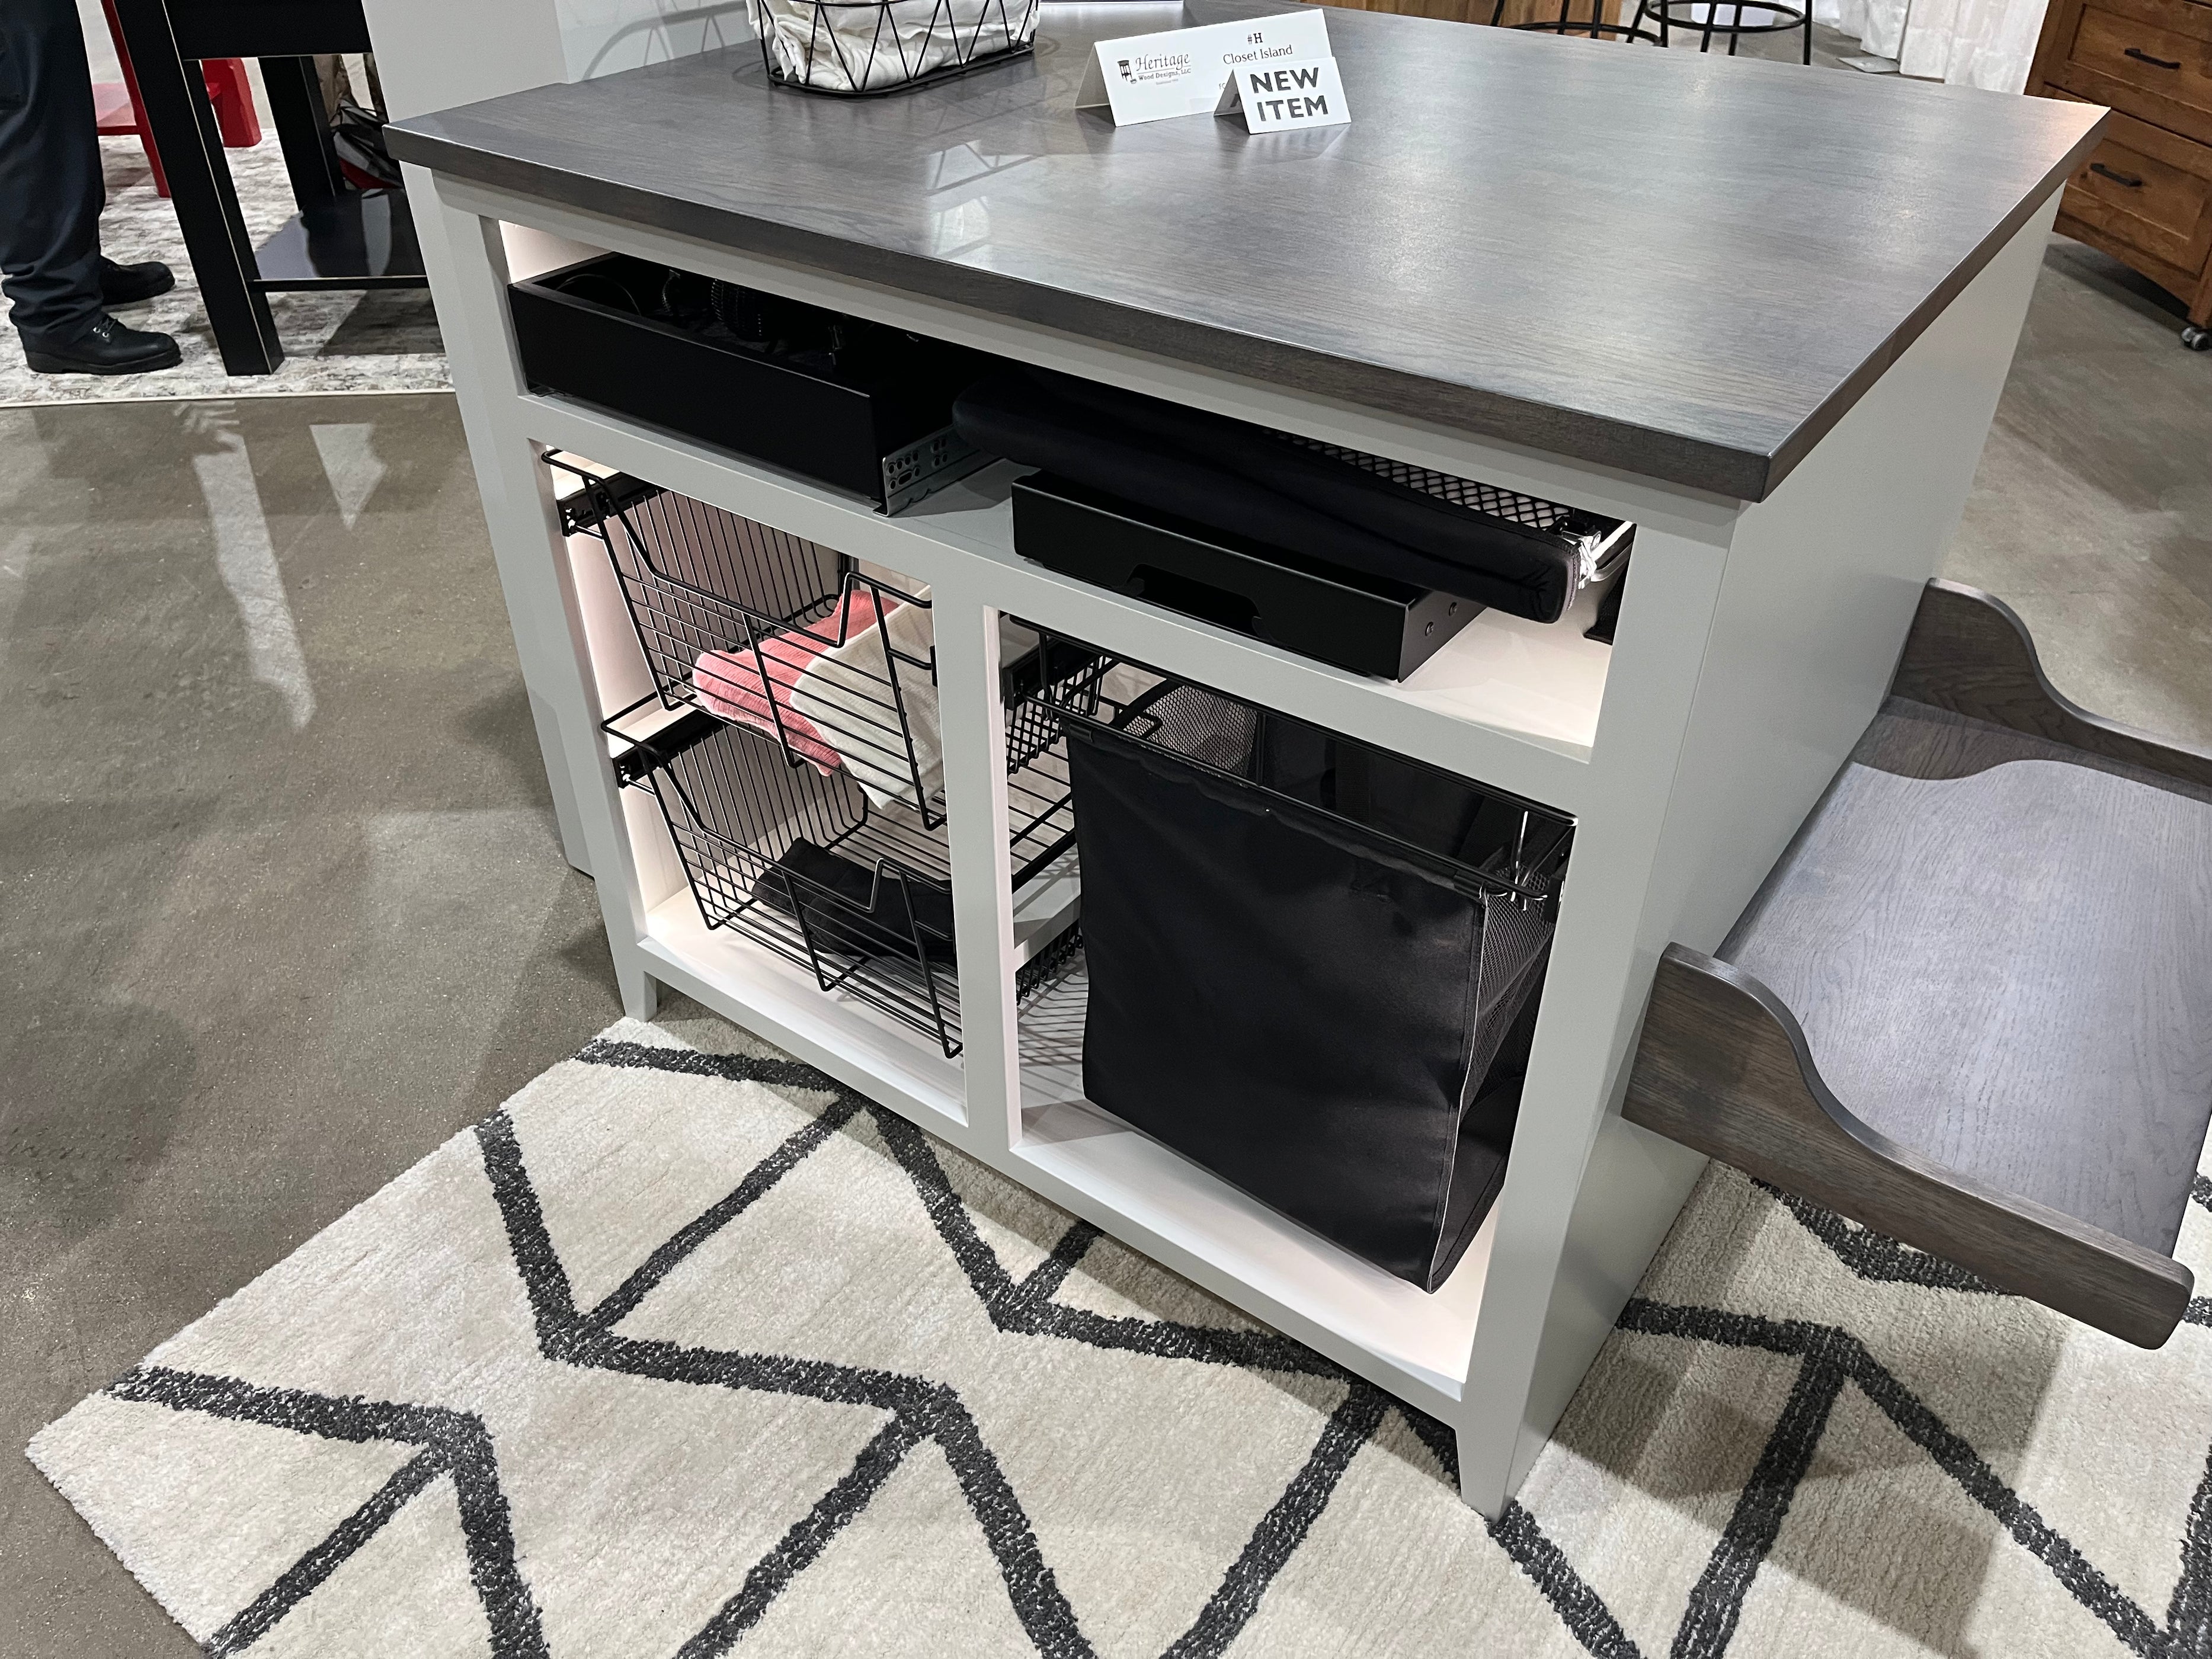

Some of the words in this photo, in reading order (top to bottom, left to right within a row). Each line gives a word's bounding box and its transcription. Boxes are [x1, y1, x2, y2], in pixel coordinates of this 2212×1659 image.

[1247, 33, 1263, 44] #H
[1135, 54, 1190, 71] Heritage
[1223, 51, 1257, 65] Closet
[1260, 44, 1293, 59] Island
[1250, 67, 1318, 93] NEW
[1257, 95, 1328, 121] ITEM
